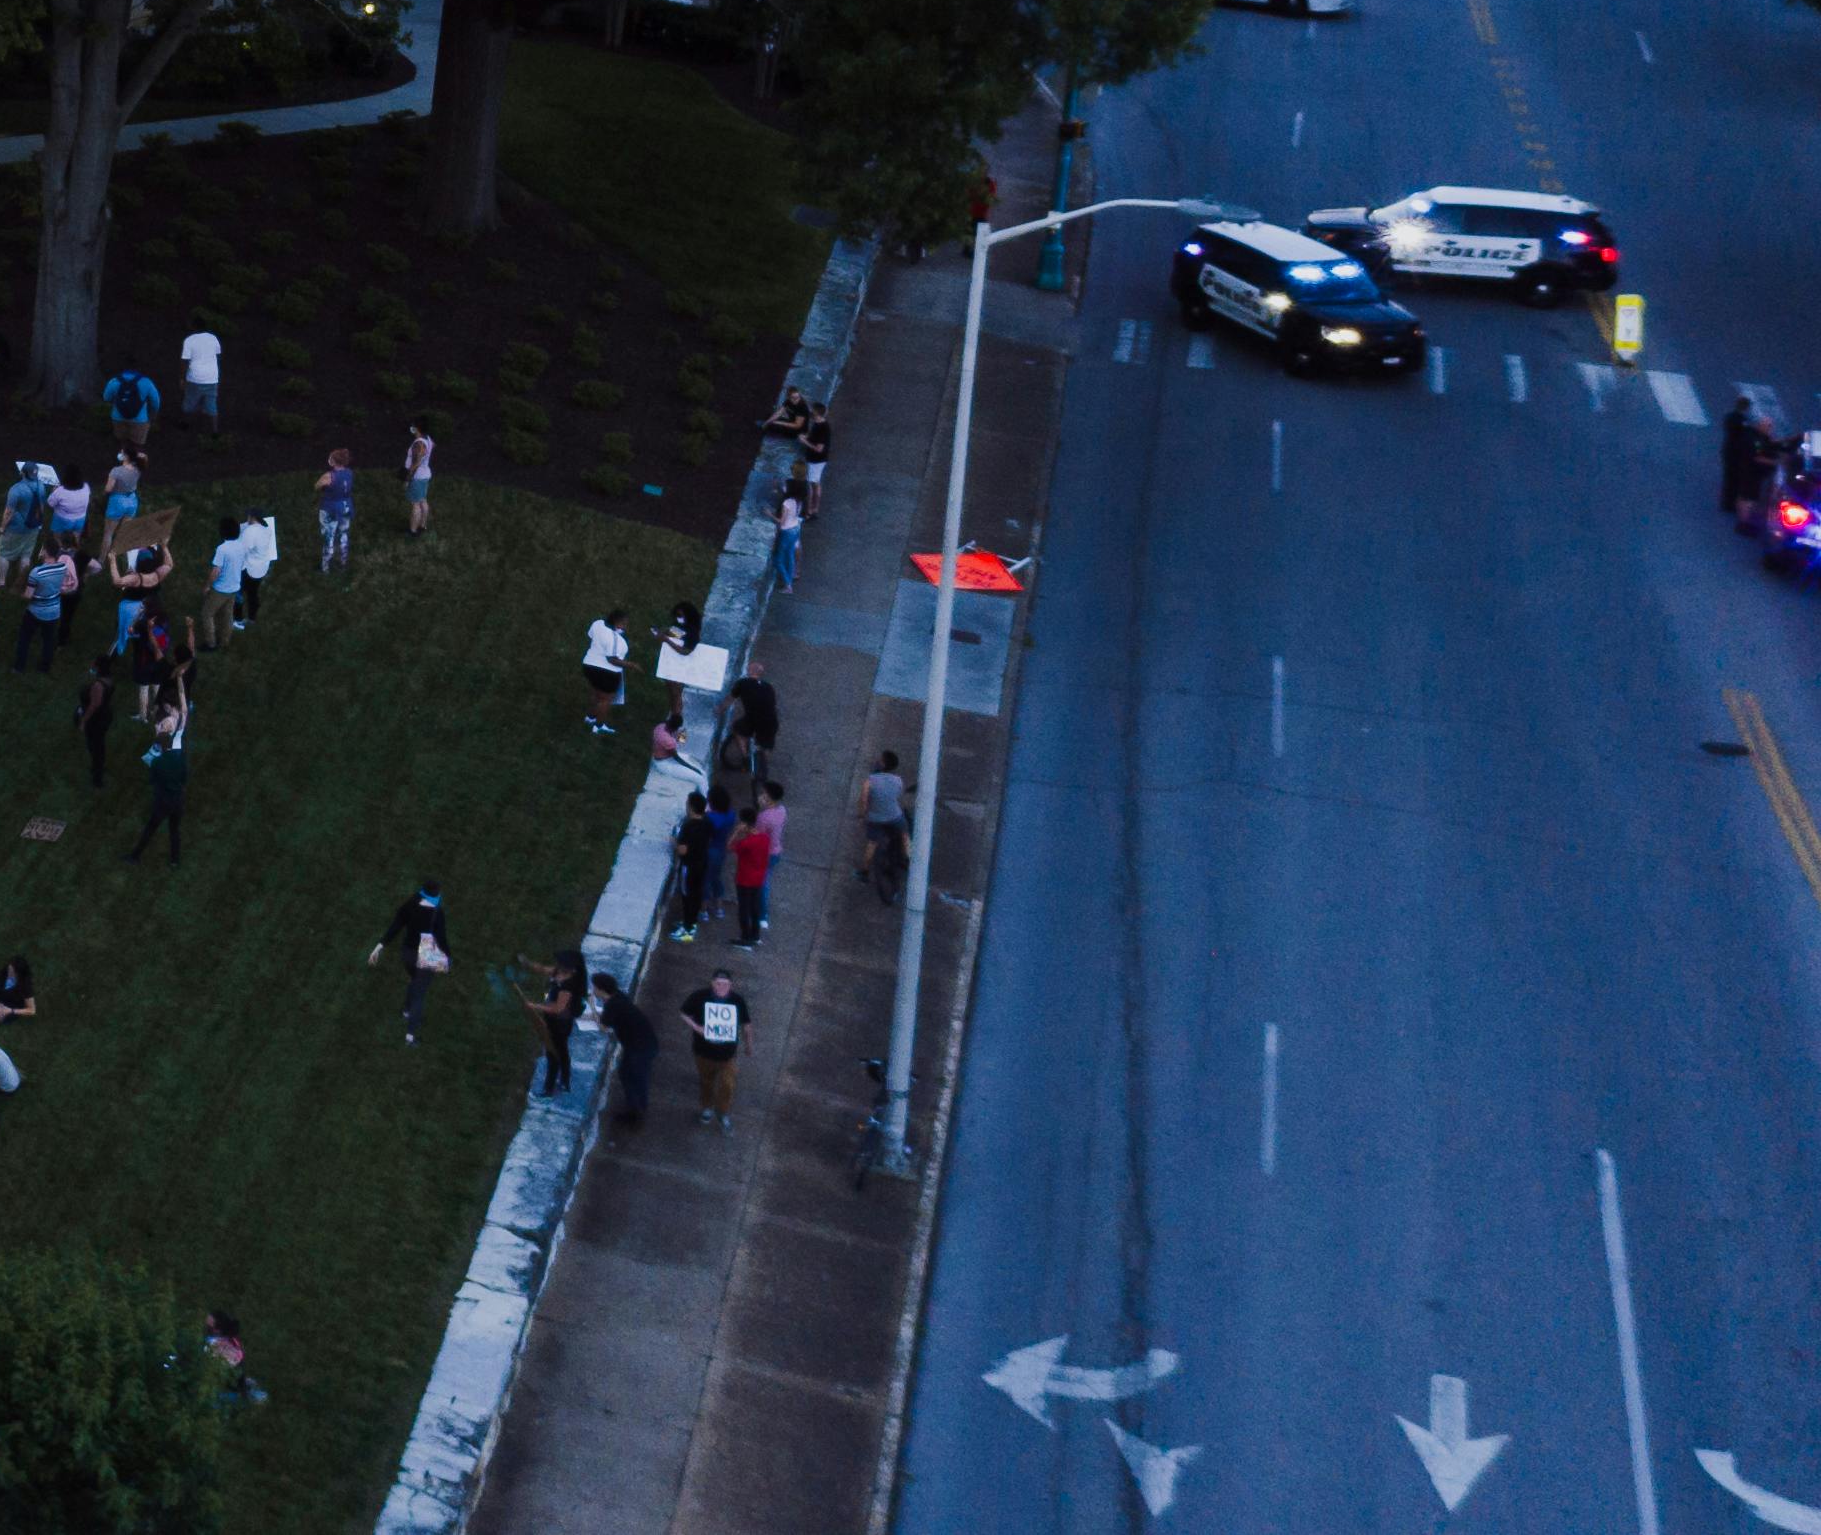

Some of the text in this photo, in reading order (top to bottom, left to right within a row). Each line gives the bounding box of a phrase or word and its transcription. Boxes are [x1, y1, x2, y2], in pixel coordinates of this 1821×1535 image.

[1424, 245, 1530, 261] POLICE
[1203, 275, 1263, 316] POLICE
[708, 1006, 732, 1021] NO
[706, 1024, 735, 1038] MORE
